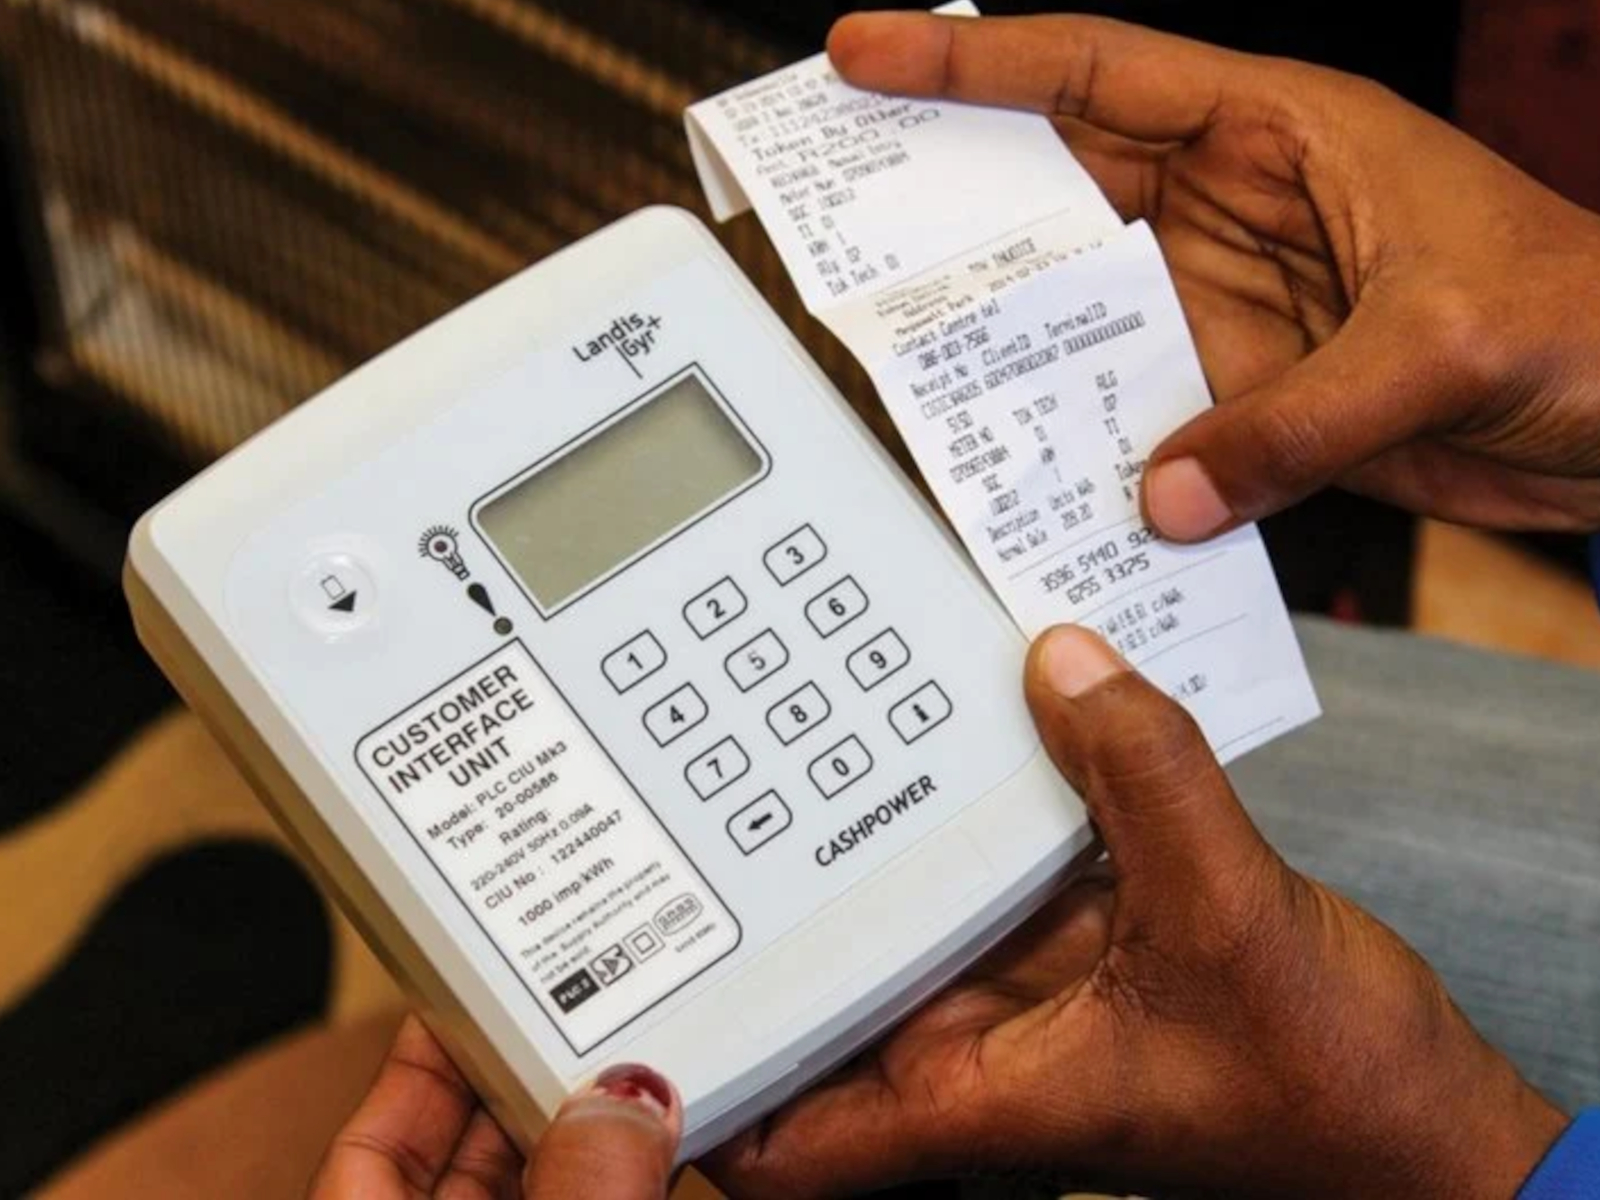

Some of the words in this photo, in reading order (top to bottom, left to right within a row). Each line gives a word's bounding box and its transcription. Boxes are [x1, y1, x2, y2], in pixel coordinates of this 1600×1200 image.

[752, 136, 813, 160] Token
[821, 125, 848, 139] By
[855, 104, 913, 127] Other
[850, 265, 880, 286] Tech
[572, 313, 644, 362] Landis
[892, 326, 938, 356] Contact
[938, 311, 978, 337] Centre
[981, 299, 1001, 320] tel
[909, 370, 952, 398] Receipt
[953, 363, 969, 377] No
[949, 434, 979, 458] METER
[987, 509, 1040, 544] Description
[786, 545, 805, 565] 3
[1077, 541, 1119, 573] 5440
[1066, 576, 1102, 605] 6755
[1104, 552, 1151, 585] 3375
[706, 598, 726, 619] 2
[828, 597, 846, 617] 6
[627, 651, 644, 671] 1
[747, 651, 766, 671] 5
[869, 650, 887, 669] 9
[372, 664, 518, 769] CUSTOMER
[669, 704, 685, 725] 4
[789, 704, 808, 724] 8
[388, 688, 535, 794] INTERFACE
[448, 737, 512, 787] UNIT
[706, 758, 722, 779] 7
[831, 757, 850, 777] 0
[427, 803, 478, 840] Model:
[475, 780, 507, 807] PLC
[508, 761, 536, 785] CIU
[535, 740, 568, 767] Mk3
[446, 819, 489, 850] Type:
[499, 808, 552, 845] Rating:
[815, 775, 938, 868] CASHPOWER
[470, 847, 526, 891] 220-240V
[527, 828, 560, 853] 50Hz
[484, 886, 513, 911] CIU
[514, 870, 537, 889] No
[550, 809, 624, 865] 122440047
[517, 899, 553, 928] 1000
[542, 923, 572, 946] device
[607, 886, 624, 900] the
[624, 861, 662, 889] property
[540, 948, 558, 963] the
[592, 899, 634, 929] Authority
